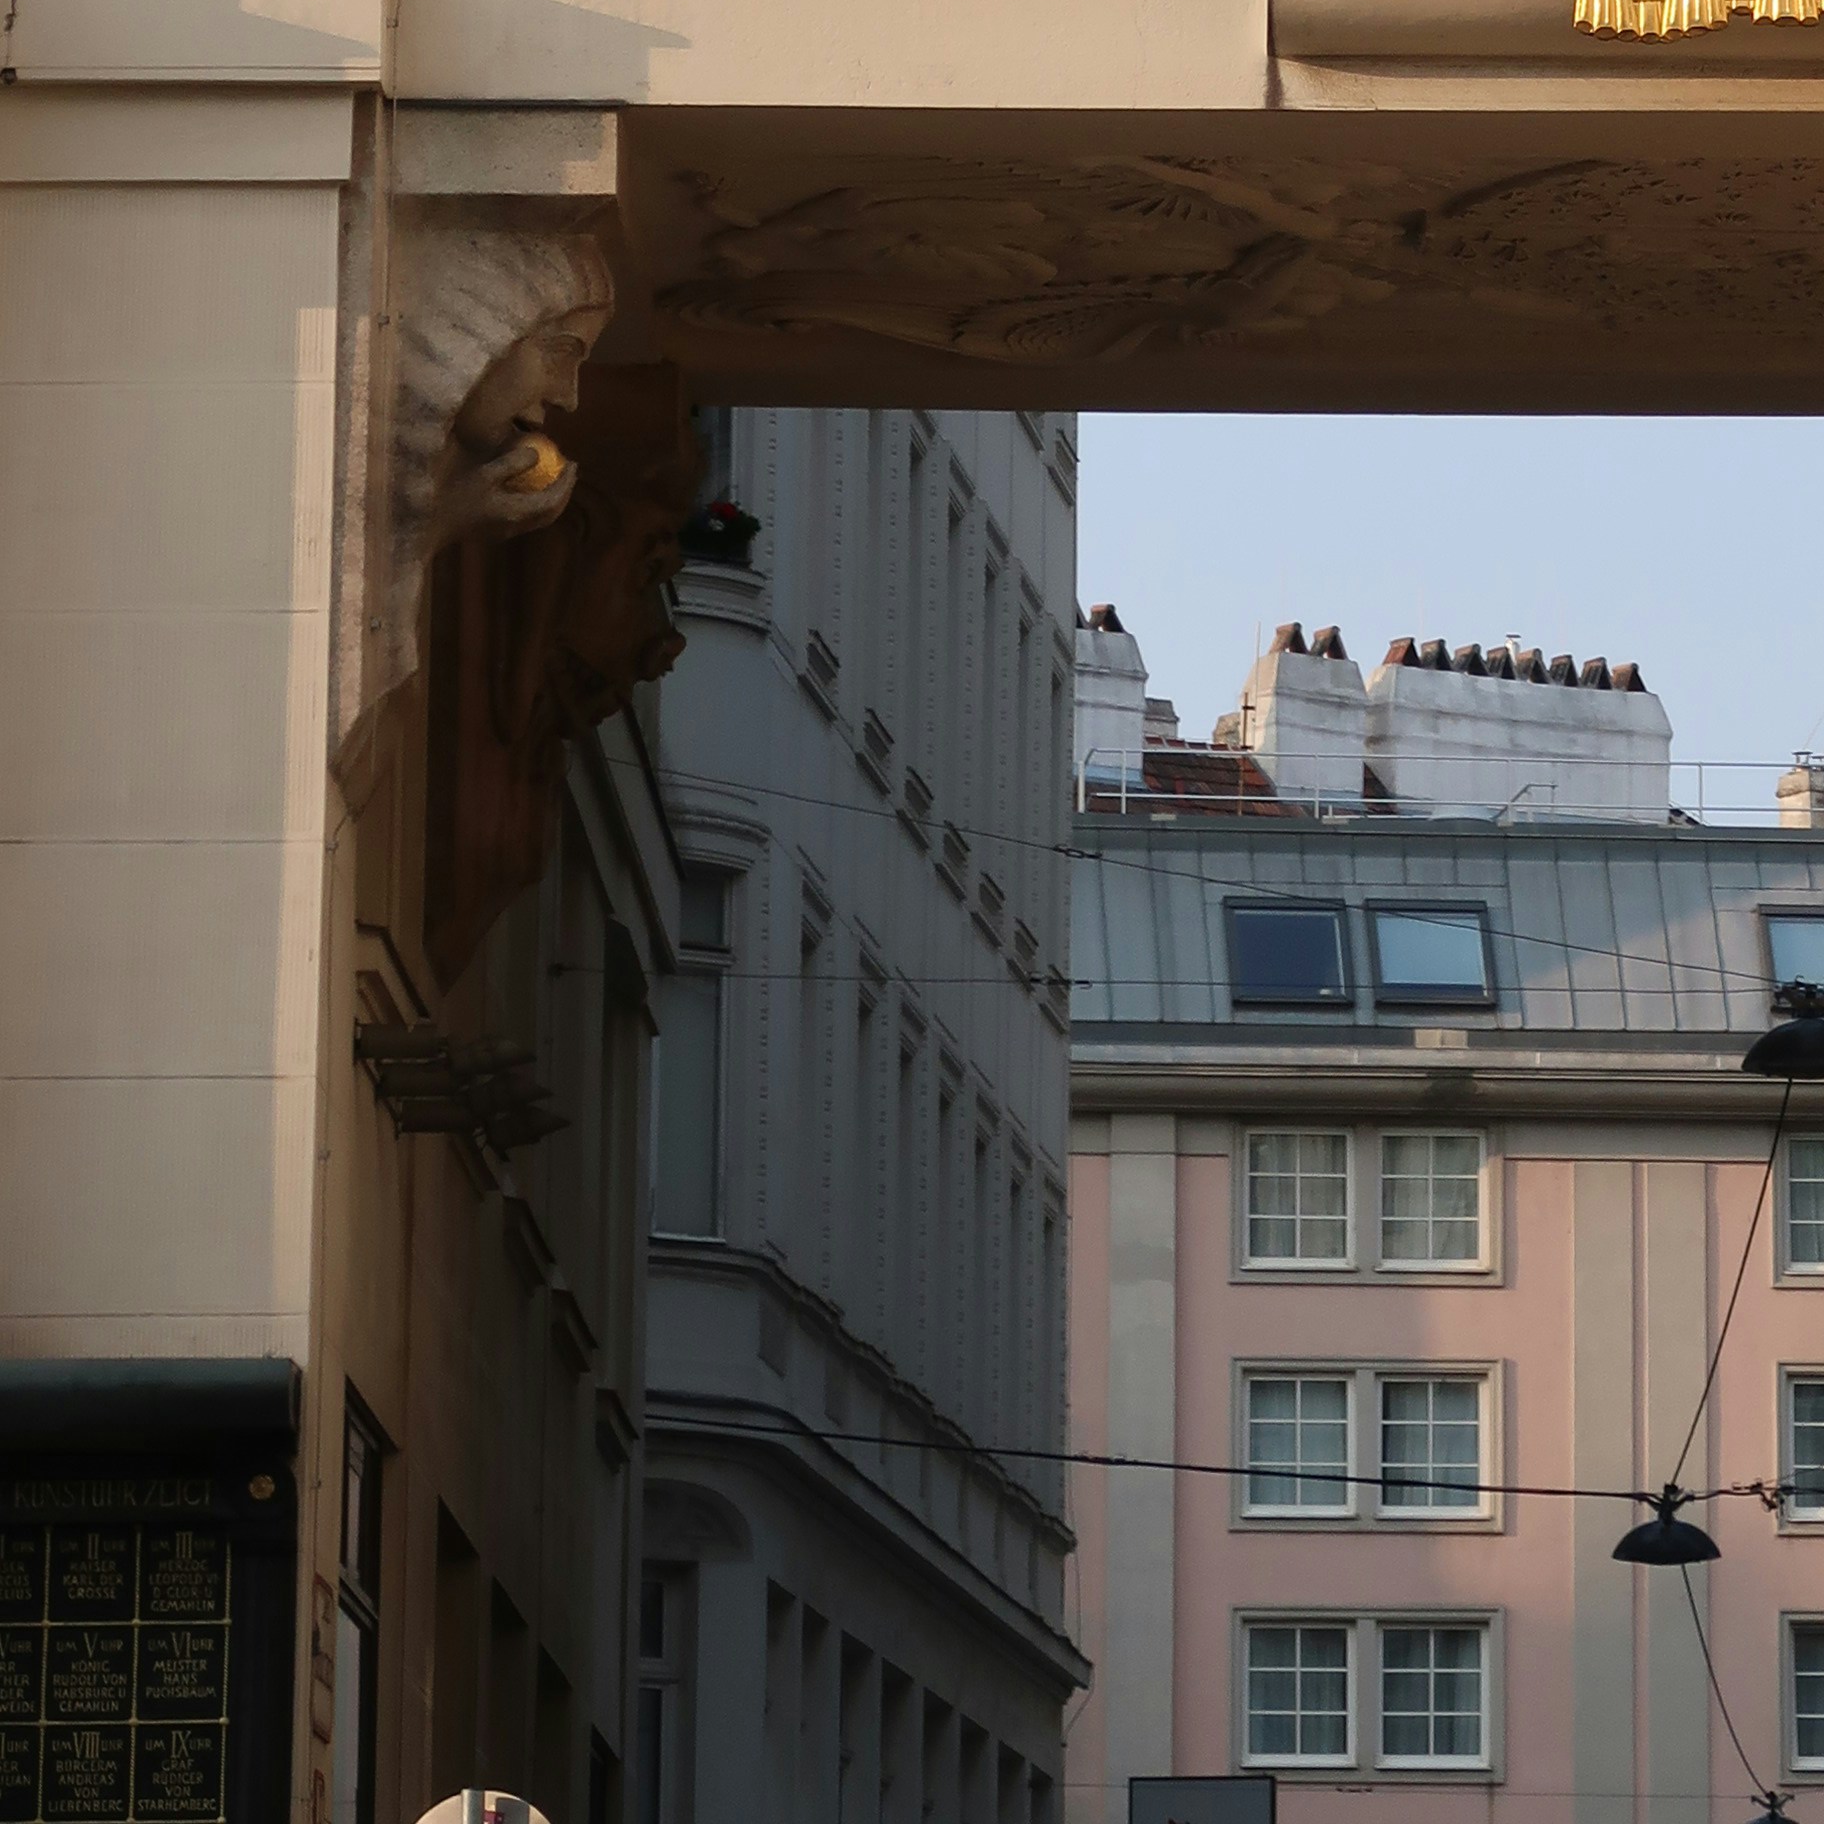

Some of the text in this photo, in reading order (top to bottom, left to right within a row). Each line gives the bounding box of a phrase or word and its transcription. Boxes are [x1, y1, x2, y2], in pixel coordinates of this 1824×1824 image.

[83, 1632, 98, 1658] V
[170, 1631, 191, 1658] VI
[152, 1659, 207, 1672] MEISTER
[163, 1672, 198, 1685] HANS
[73, 1731, 100, 1758] VIII
[171, 1730, 192, 1758] IX
[58, 1773, 115, 1786] ANDREAS
[74, 1787, 99, 1798] VON
[164, 1785, 191, 1797] VON
